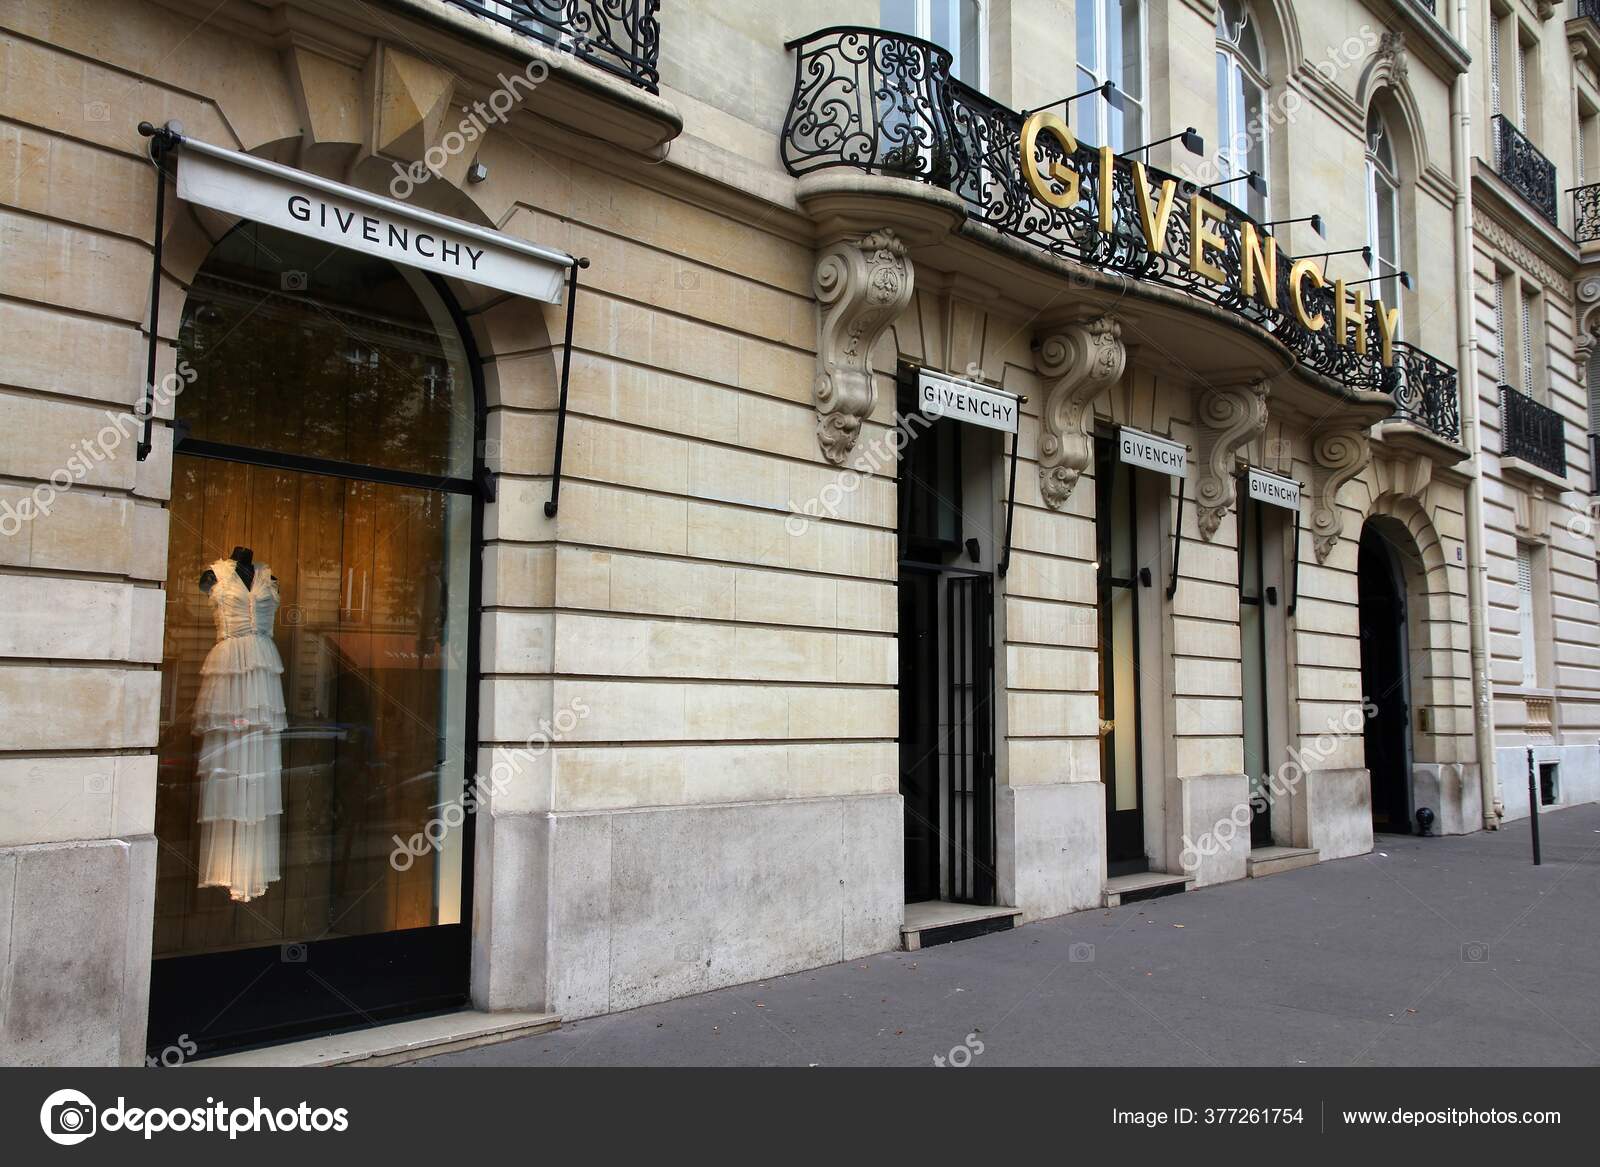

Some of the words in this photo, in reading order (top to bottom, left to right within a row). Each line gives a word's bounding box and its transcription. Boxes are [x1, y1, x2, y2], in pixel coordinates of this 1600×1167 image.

[287, 195, 484, 270] GIVENCHY
[1020, 112, 1399, 367] GIVENCHY
[924, 386, 1012, 421] GIVENCHY
[1123, 440, 1184, 469] GIVENCHY
[1251, 479, 1298, 502] GIVENCHY
